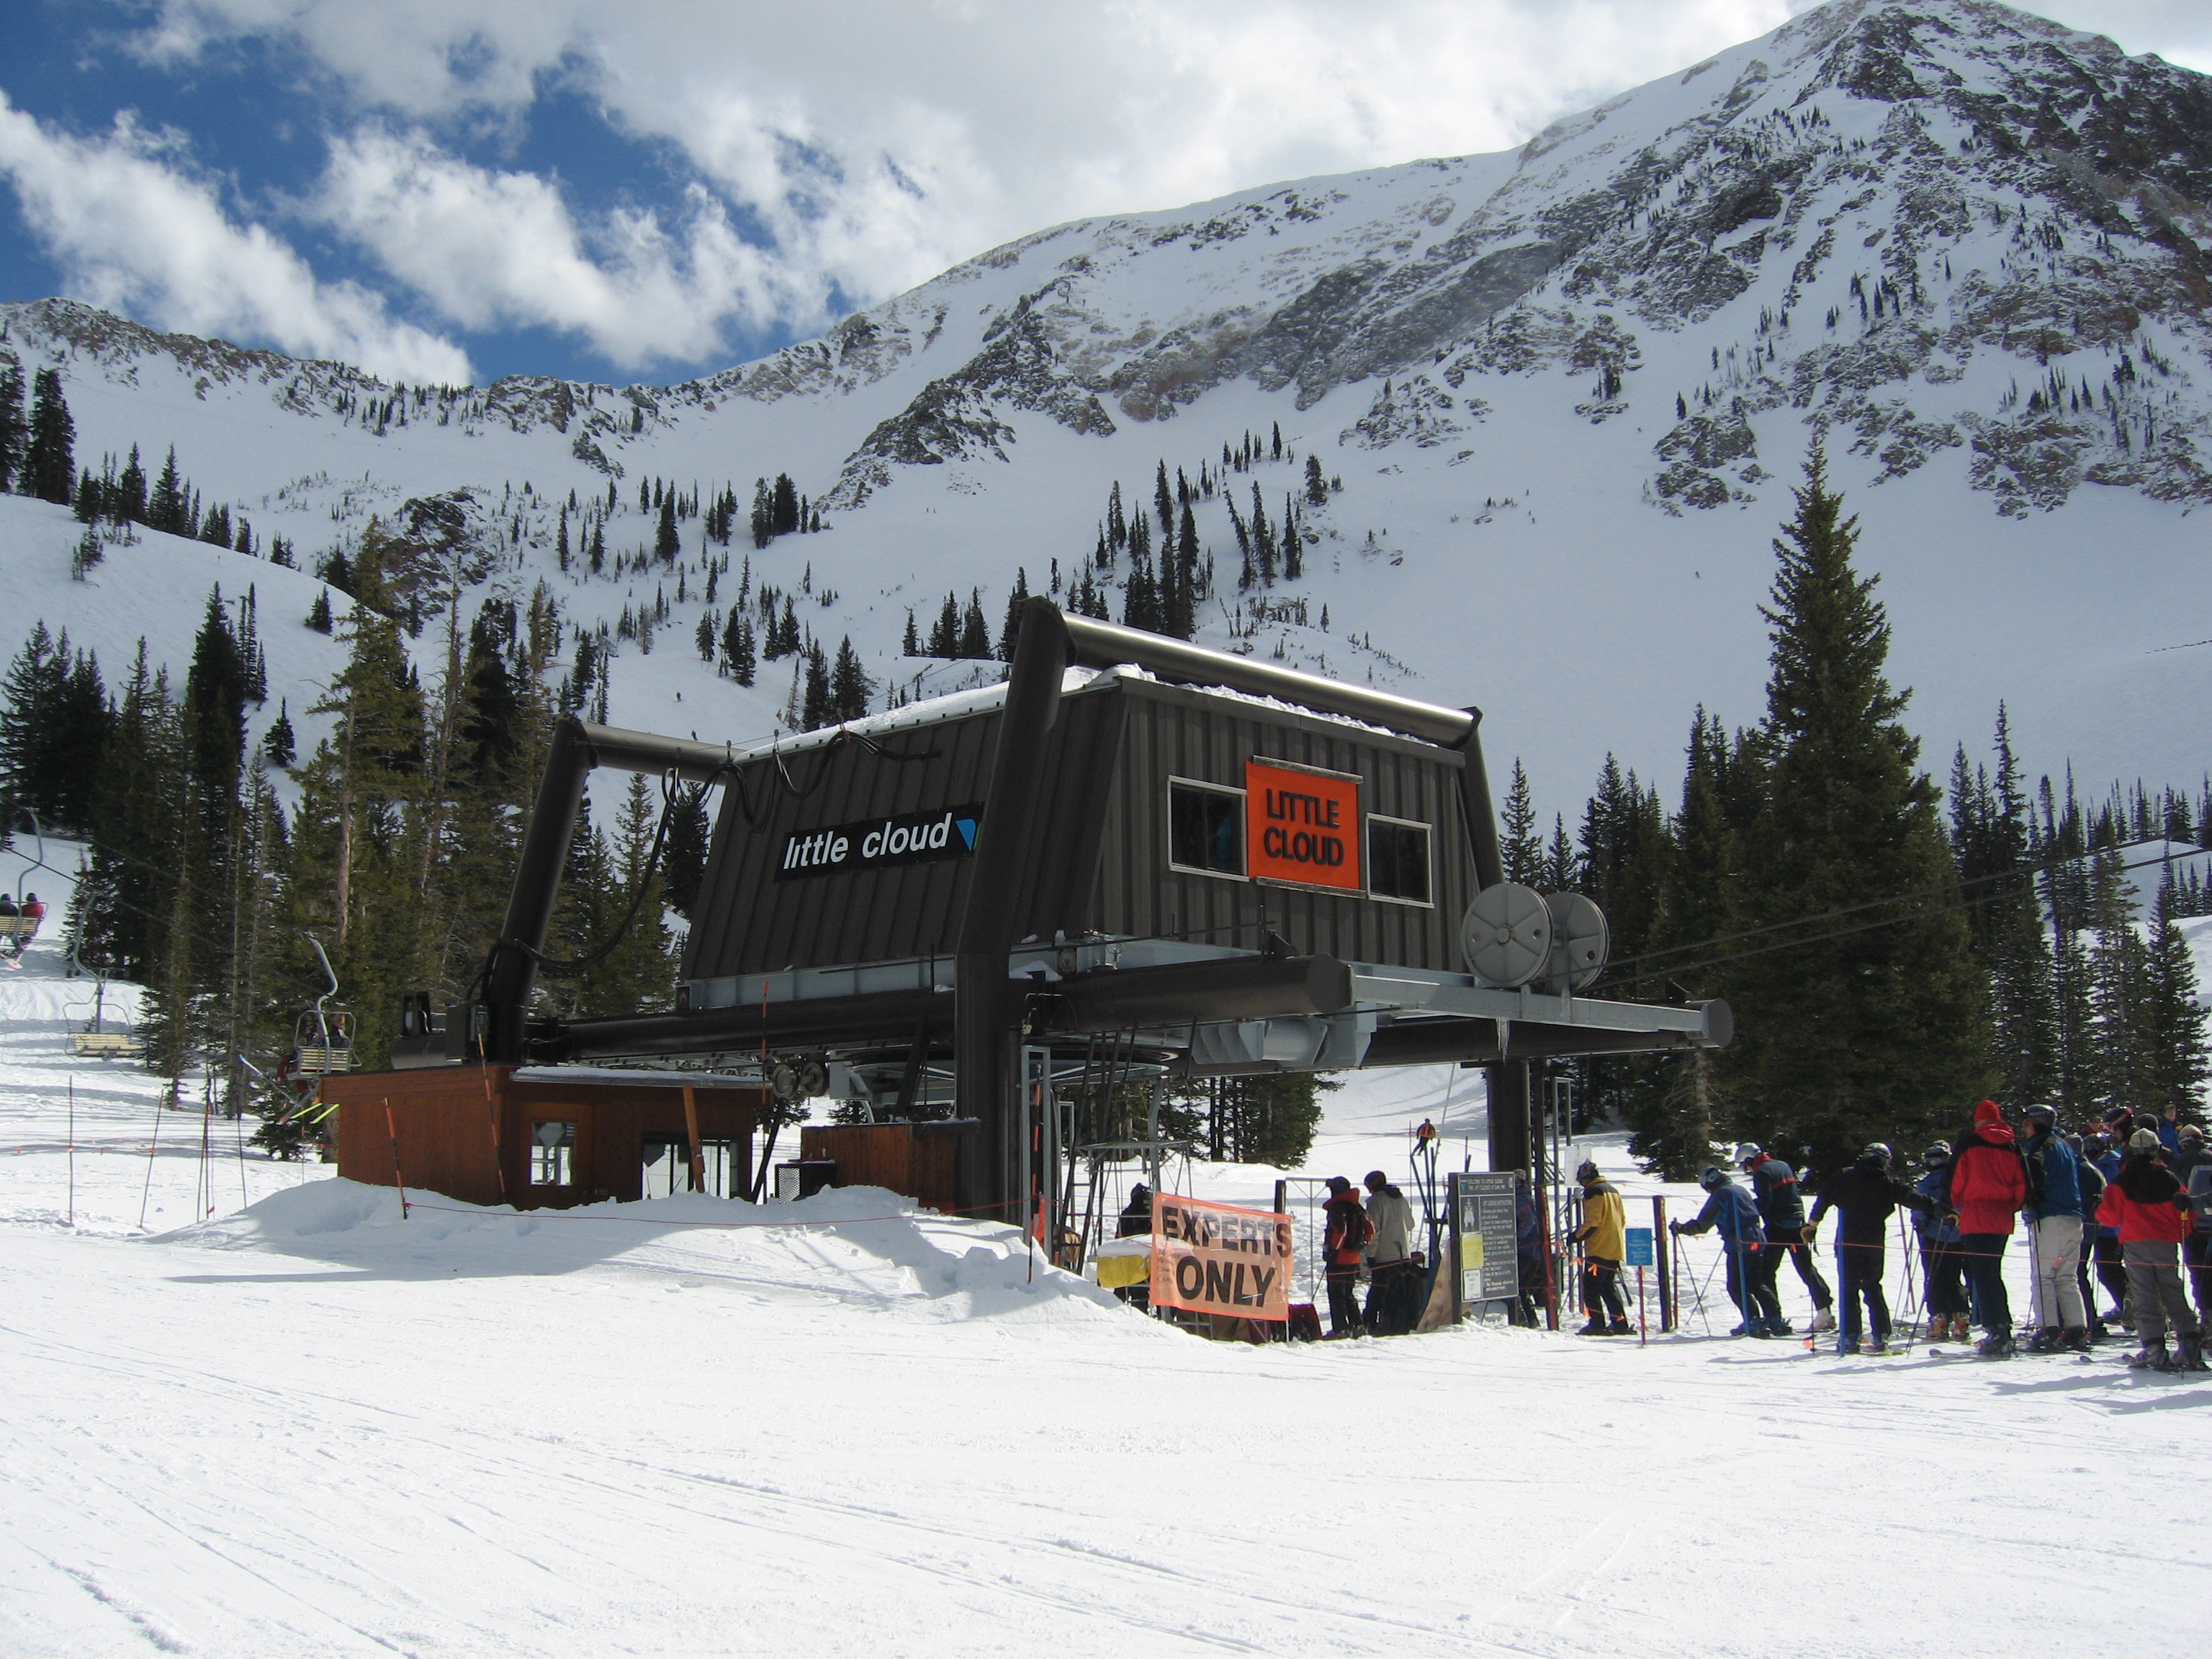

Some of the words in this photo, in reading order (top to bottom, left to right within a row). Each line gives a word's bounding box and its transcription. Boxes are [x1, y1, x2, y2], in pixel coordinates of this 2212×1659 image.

[1267, 788, 1340, 830] LITTLE
[783, 831, 849, 869] little
[863, 812, 952, 858] cloud
[1264, 827, 1344, 866] CLOUD
[1162, 1206, 1292, 1258] EXPERTS
[1176, 1255, 1277, 1308] ONLY
